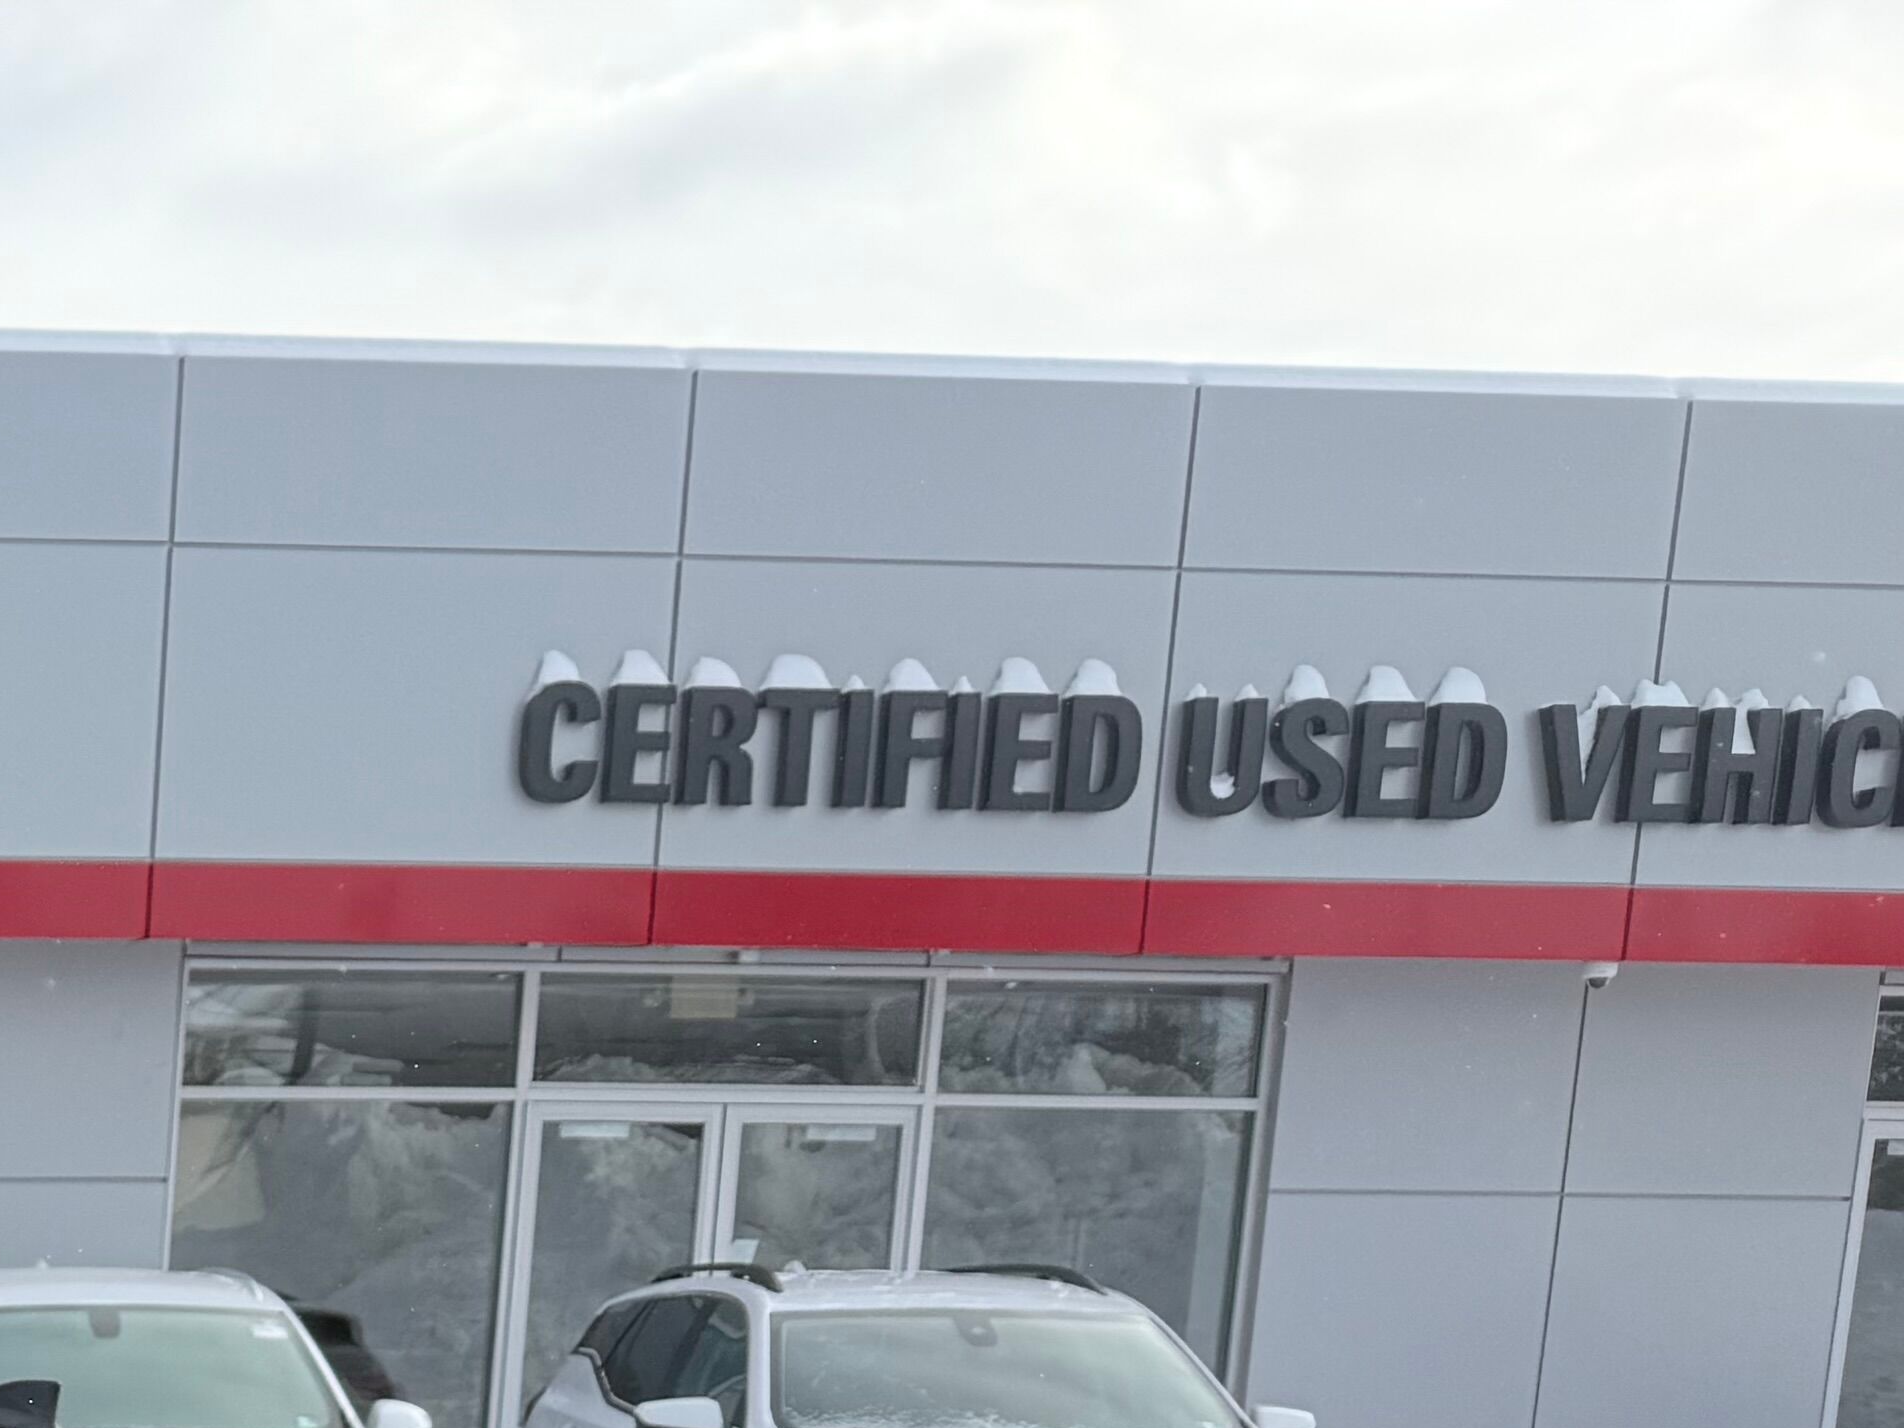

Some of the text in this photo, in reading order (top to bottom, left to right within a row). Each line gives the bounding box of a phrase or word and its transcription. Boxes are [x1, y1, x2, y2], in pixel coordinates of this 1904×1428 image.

[518, 680, 1904, 829] CERTIFIED USED VEHIC
